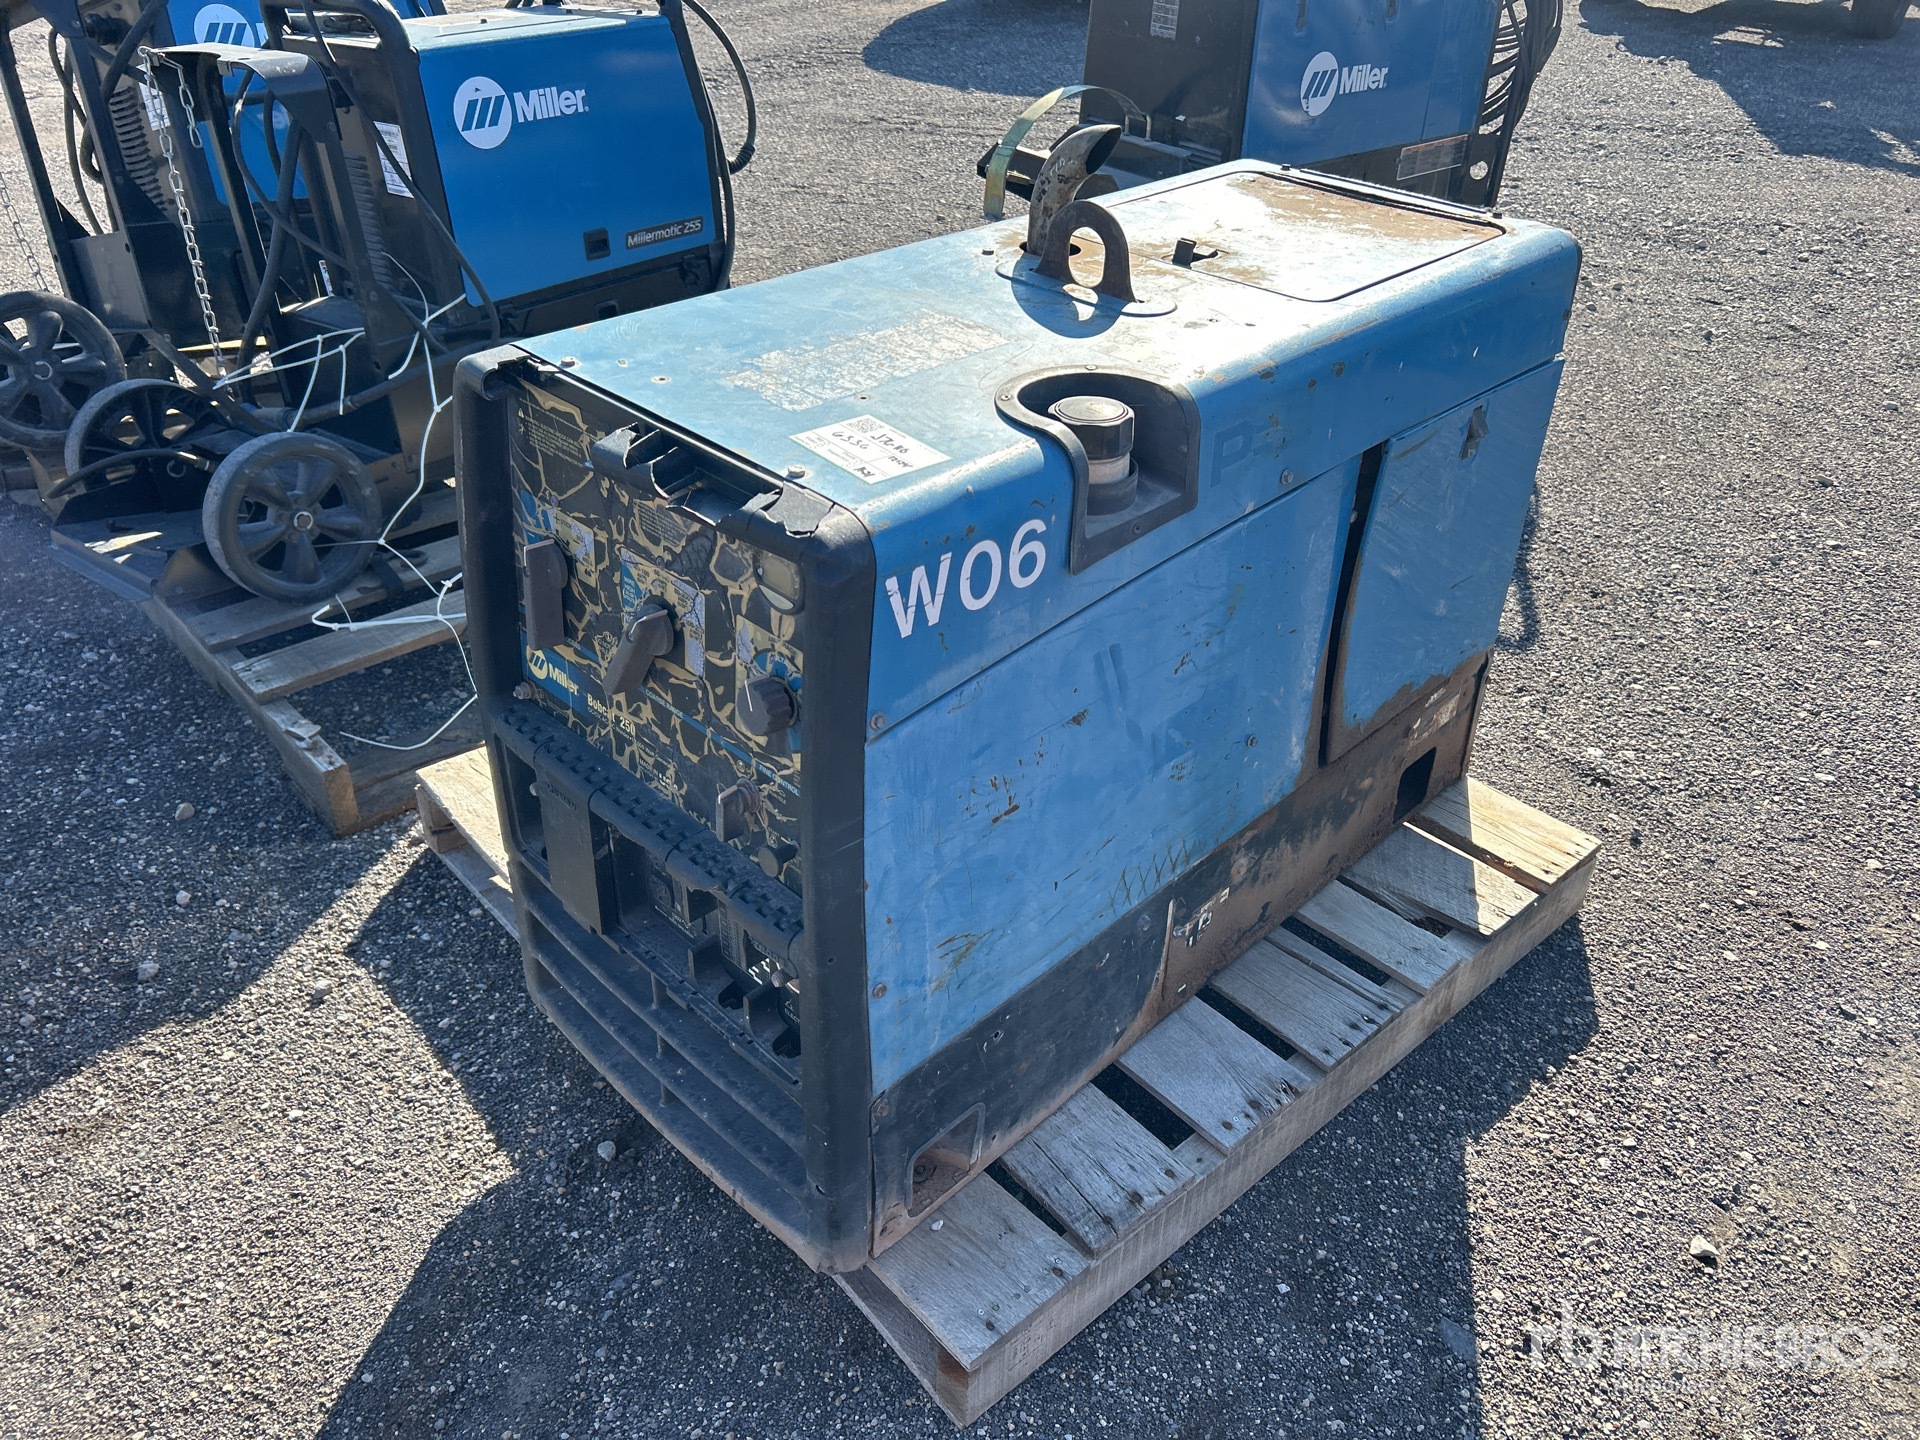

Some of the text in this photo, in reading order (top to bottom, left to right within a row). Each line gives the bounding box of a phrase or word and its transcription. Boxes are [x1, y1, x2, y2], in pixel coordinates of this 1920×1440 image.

[1339, 64, 1389, 95] Miller
[513, 87, 586, 122] Miller
[627, 219, 702, 247] Millermatic 255
[548, 662, 579, 696] Miller
[587, 692, 616, 722] Bobct
[619, 716, 636, 737] 250
[772, 773, 800, 797] CNTROL
